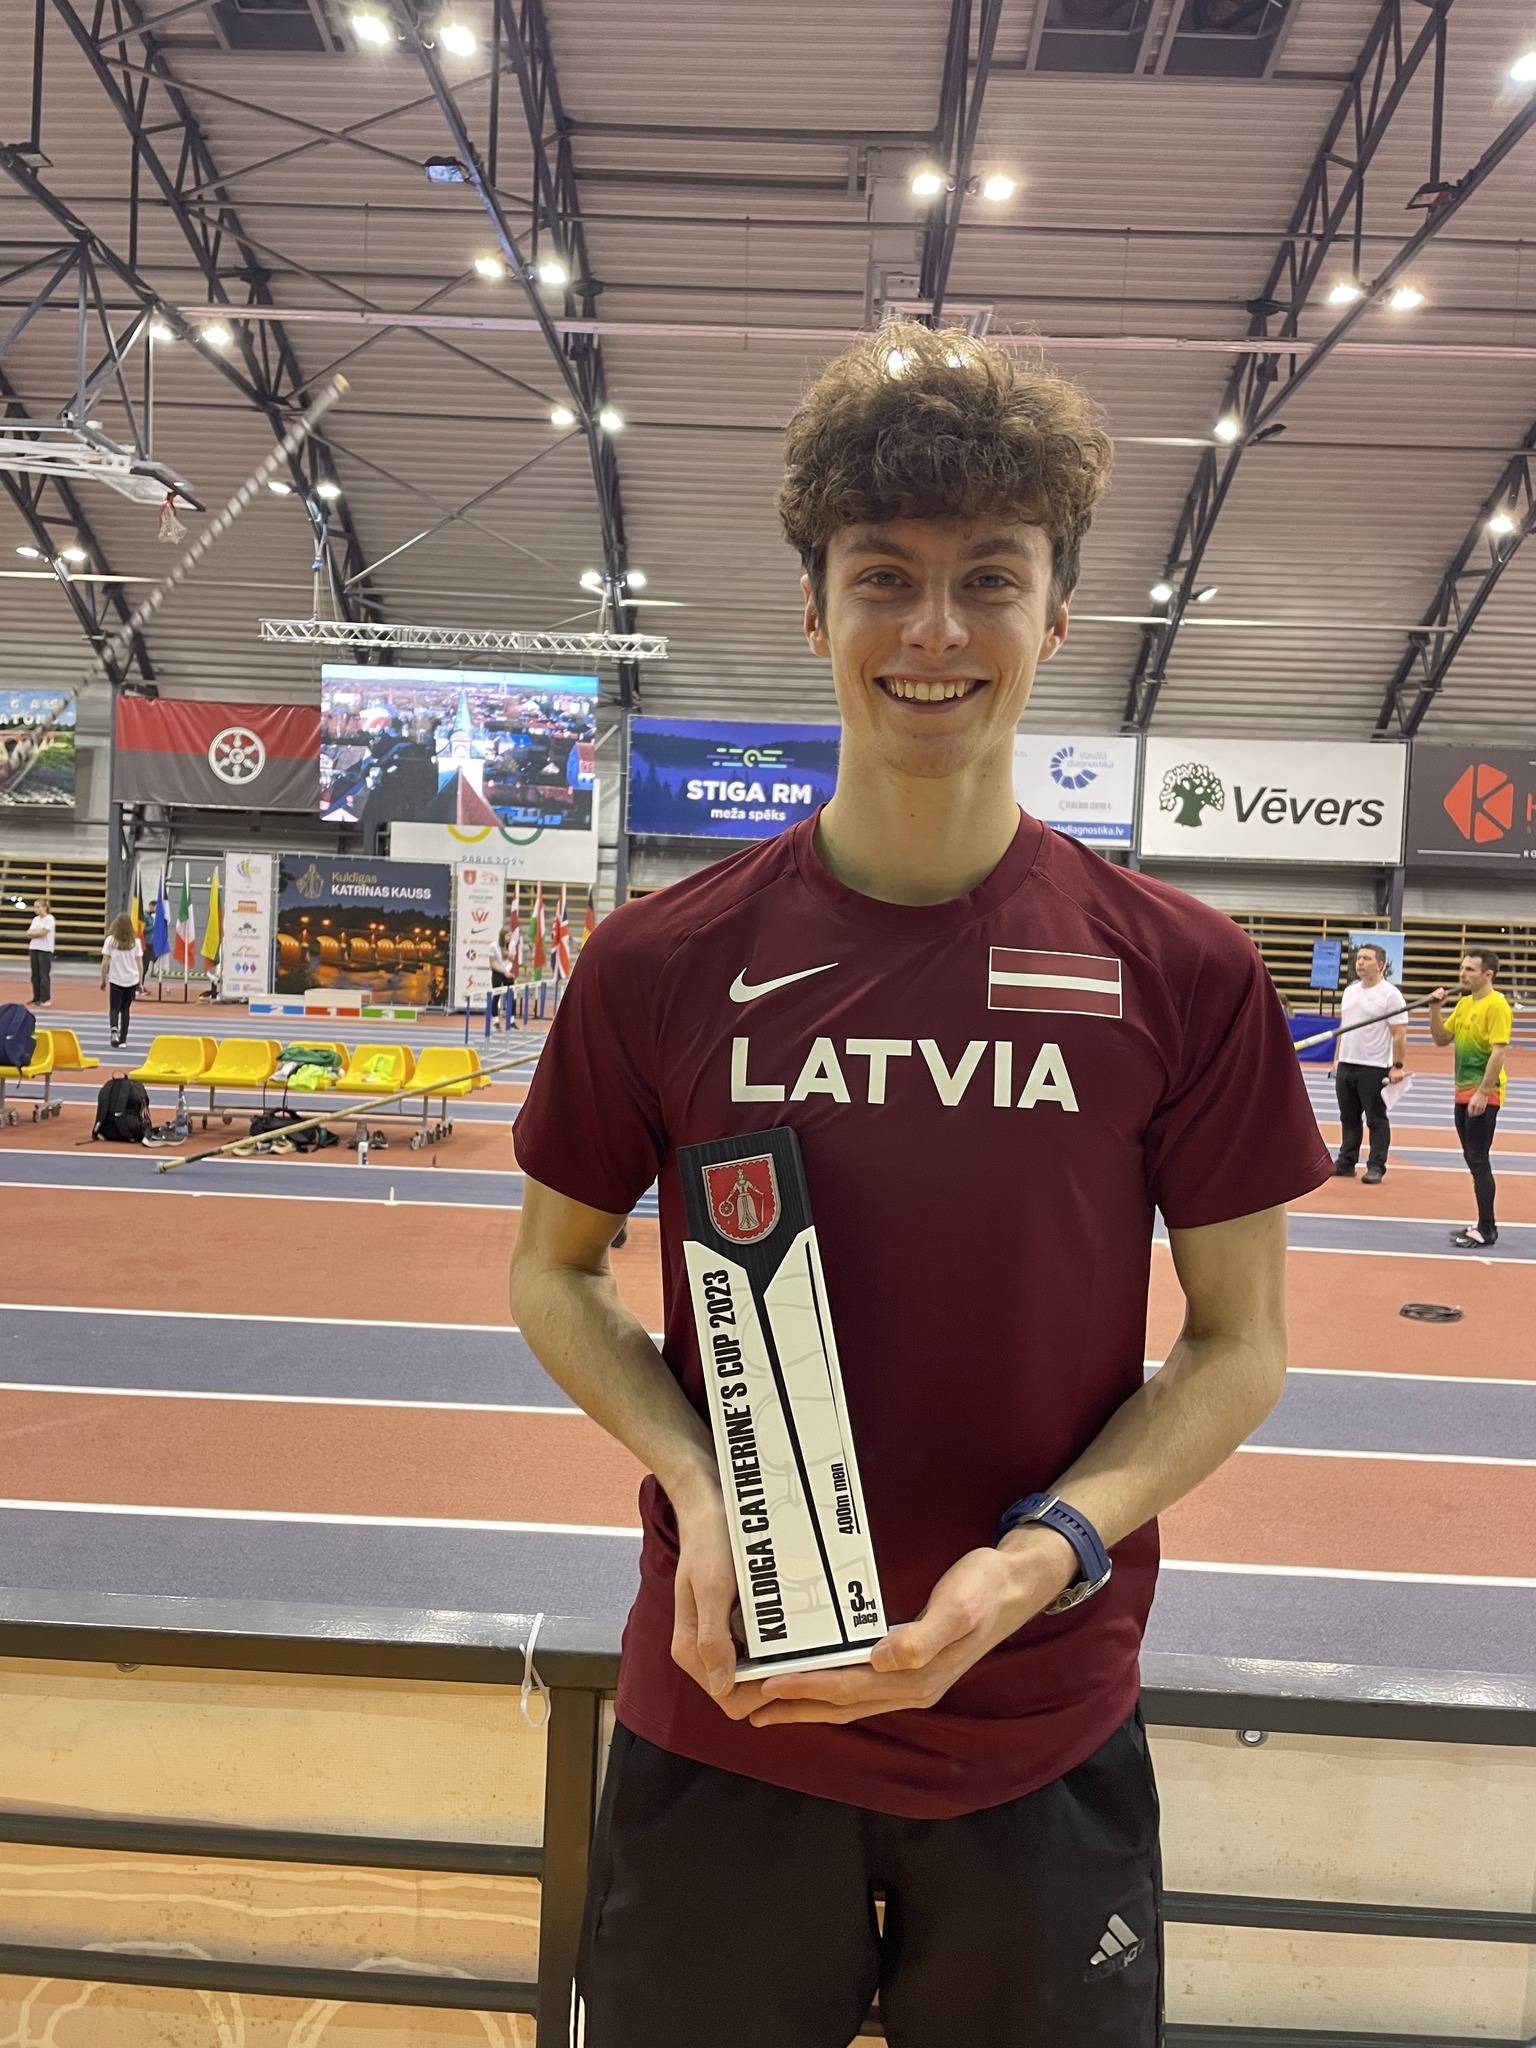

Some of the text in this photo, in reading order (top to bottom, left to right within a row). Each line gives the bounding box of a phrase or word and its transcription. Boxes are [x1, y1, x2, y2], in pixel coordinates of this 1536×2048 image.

[686, 780, 812, 804] STIGA RM
[1233, 785, 1385, 827] Vēvers
[710, 807, 786, 822] meža spēks
[461, 855, 524, 865] PARIS 2024
[331, 884, 432, 900] KATRĪNAS KAUSS
[731, 1037, 1080, 1112] LATVIA
[702, 1269, 737, 1328] 2023
[712, 1333, 744, 1379] CUP
[831, 1463, 854, 1534] 400m men
[745, 1537, 788, 1643] KULDIGA
